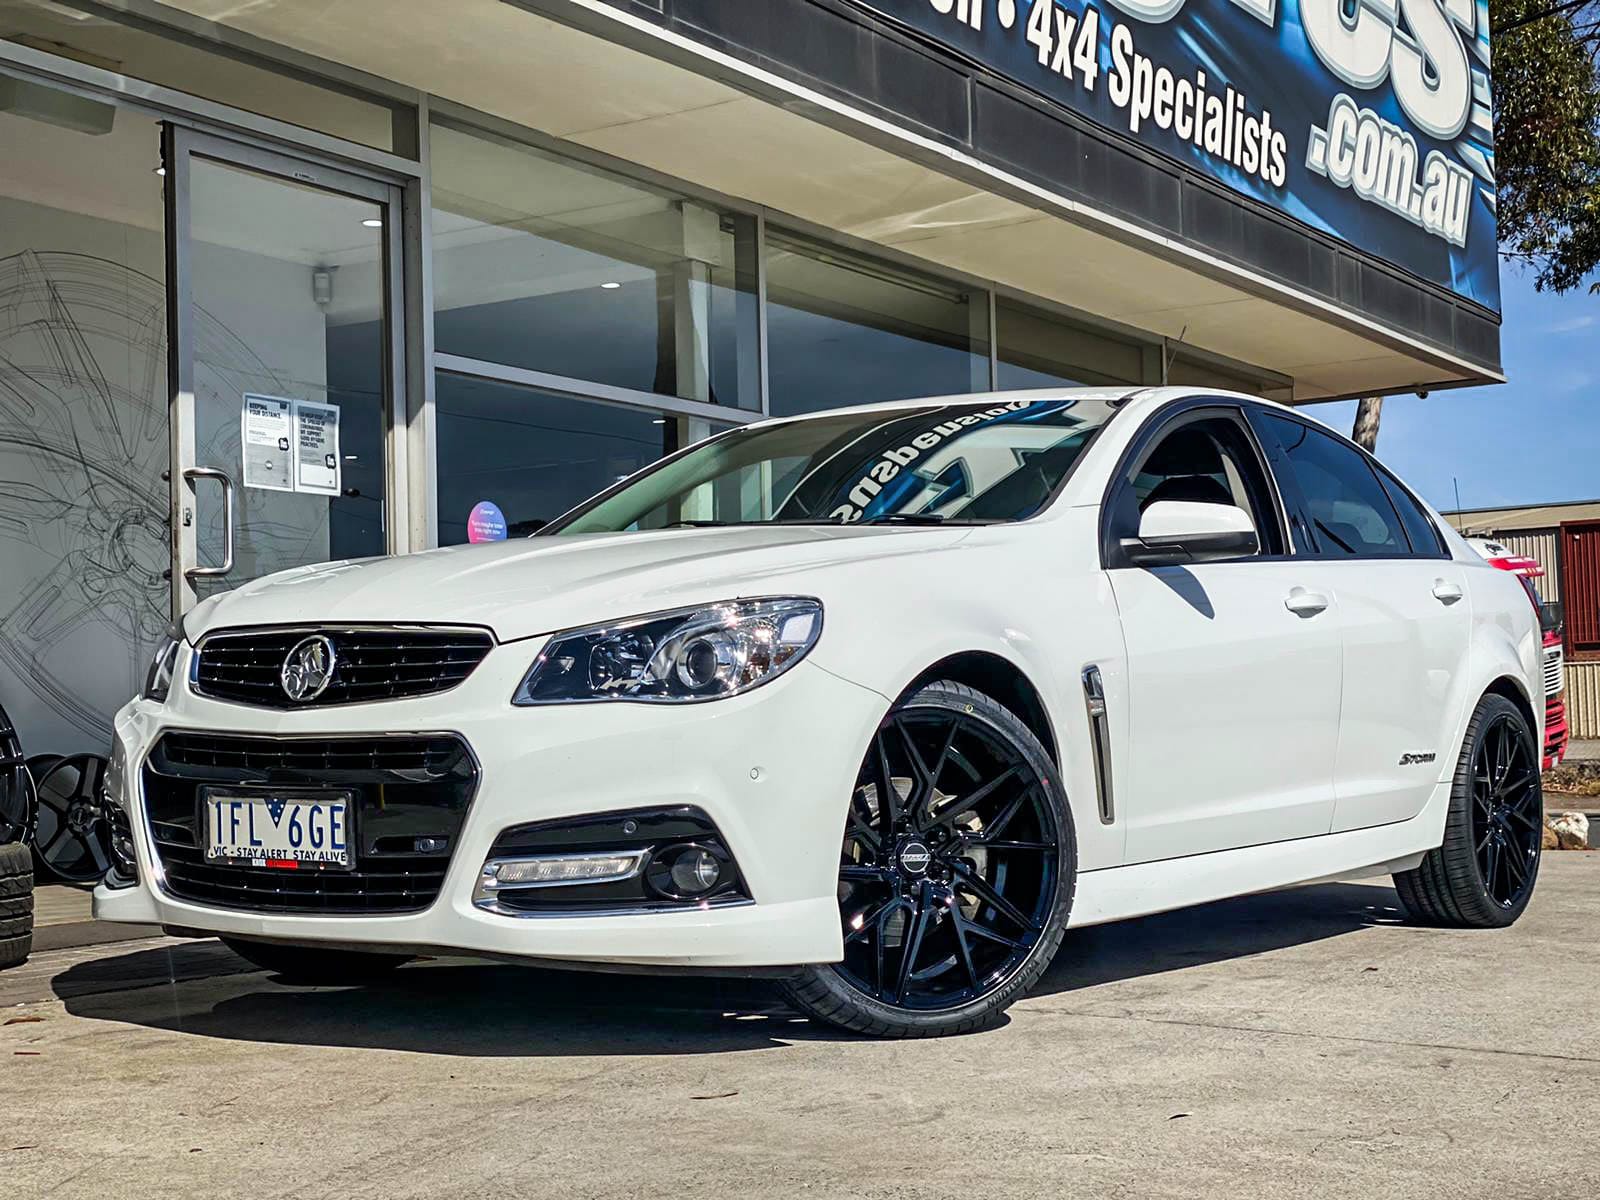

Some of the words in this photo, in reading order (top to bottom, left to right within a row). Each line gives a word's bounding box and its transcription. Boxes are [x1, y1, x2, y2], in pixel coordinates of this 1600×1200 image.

[1026, 0, 1099, 91] 4x4
[1108, 23, 1287, 187] Specialists
[1308, 97, 1472, 245] .com.au
[213, 846, 228, 856] VIC
[236, 847, 258, 858] STAY
[260, 848, 287, 859] ALERT
[293, 849, 315, 860] STAY
[318, 850, 347, 862] ALIVE
[215, 800, 262, 847] 1FL
[288, 804, 346, 850] 6GE
